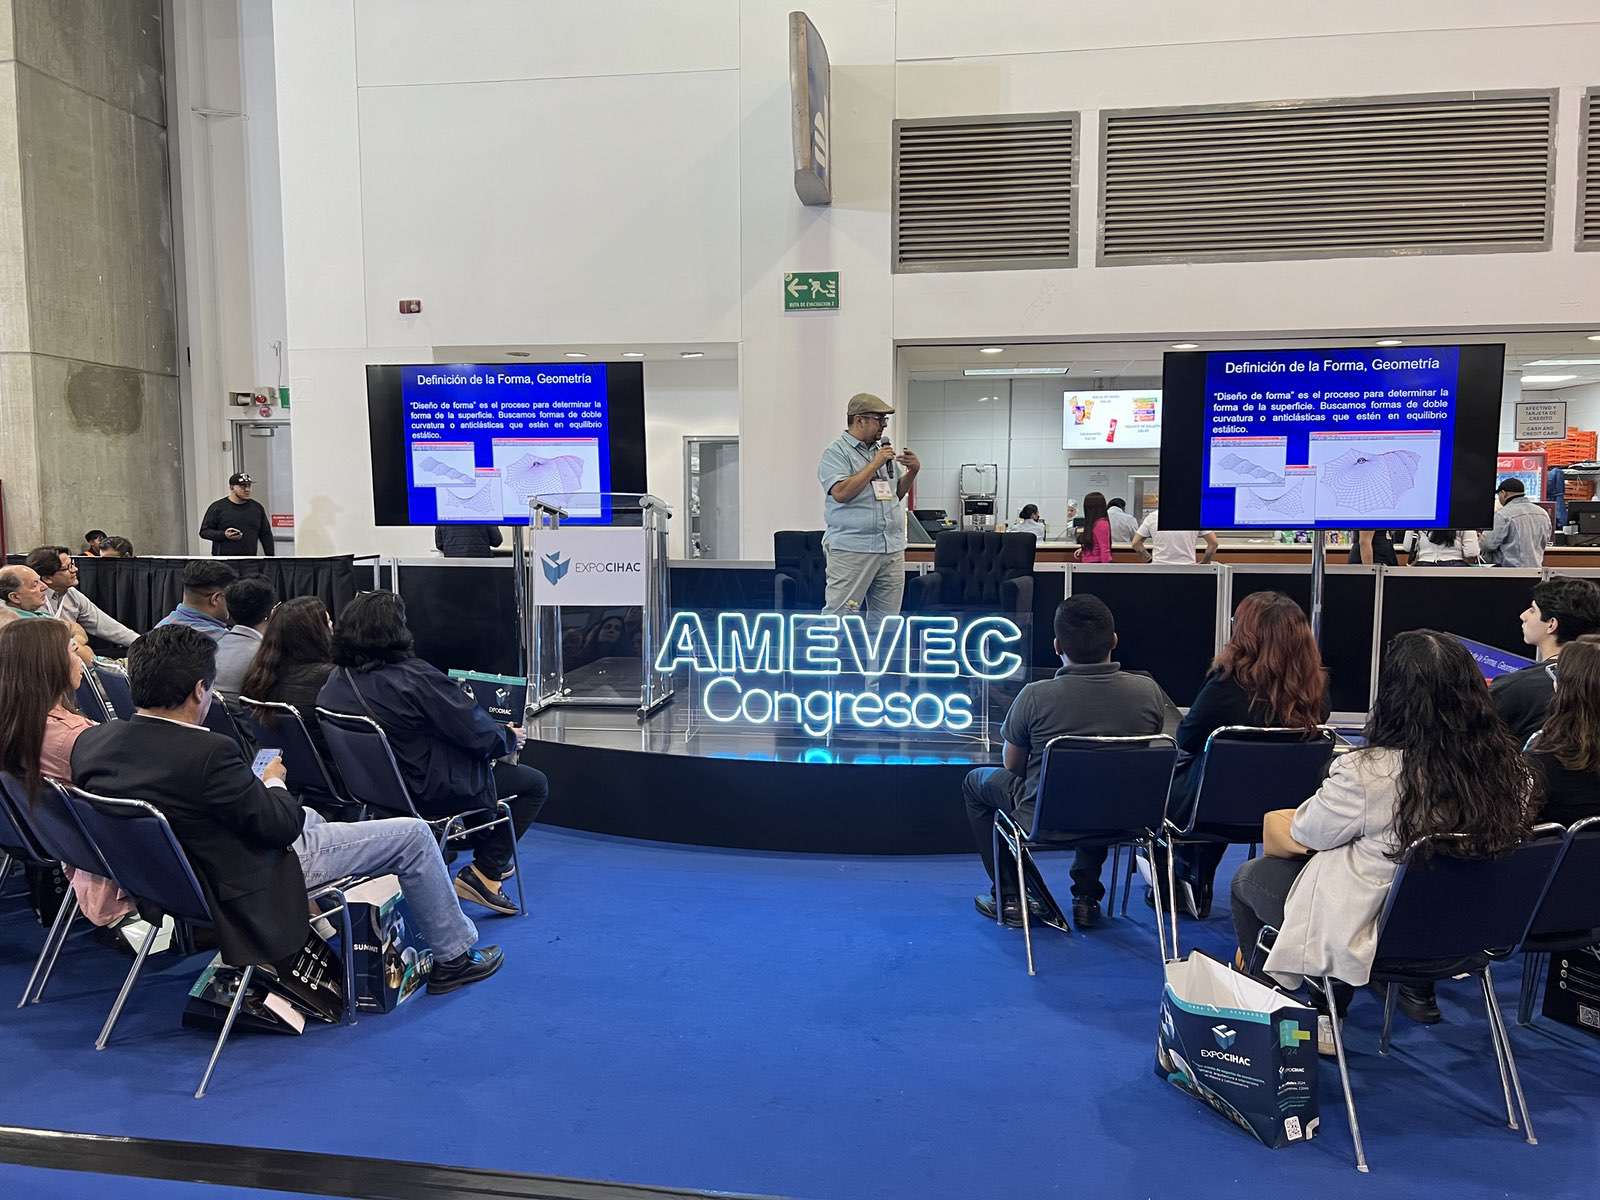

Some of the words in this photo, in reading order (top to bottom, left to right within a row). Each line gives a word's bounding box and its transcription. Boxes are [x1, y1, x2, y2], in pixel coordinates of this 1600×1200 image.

[1225, 361, 1286, 374] Definición
[1288, 360, 1306, 373] de
[1308, 360, 1320, 372] la
[1323, 359, 1368, 373] Forma,
[1371, 357, 1440, 371] Geometría
[416, 372, 468, 386] Definición
[469, 373, 483, 385] de
[485, 373, 496, 385] la
[497, 373, 534, 386] Forma,
[536, 372, 592, 385] Geometría
[1250, 391, 1263, 400] de
[1297, 392, 1310, 400] es
[1312, 390, 1321, 399] el
[1323, 391, 1361, 401] proceso
[1363, 390, 1385, 400] para
[1387, 388, 1437, 398] determinar
[1440, 388, 1449, 397] la
[440, 401, 451, 410] de
[490, 401, 499, 409] el
[500, 402, 531, 411] proceso
[532, 402, 550, 410] para
[551, 400, 592, 409] determinar
[594, 400, 602, 409] la
[1212, 403, 1239, 412] forma
[1242, 402, 1255, 412] de
[1258, 402, 1267, 411] la
[1319, 401, 1367, 410] Buscamos
[1370, 400, 1402, 410] formas
[1406, 399, 1419, 409] de
[1422, 399, 1449, 409] doble
[410, 411, 432, 420] forma
[434, 411, 445, 420] de
[447, 411, 455, 419] la
[497, 410, 537, 419] Buscamos
[539, 410, 565, 419] formas
[567, 410, 579, 419] de
[580, 410, 602, 419] doble
[1212, 414, 1254, 423] curvatura
[1259, 415, 1267, 423] o
[1271, 412, 1327, 422] anticlásticas
[1332, 413, 1350, 423] que
[1355, 411, 1381, 421] estén
[1387, 413, 1400, 421] en
[1406, 410, 1448, 421] equilibrio
[410, 421, 445, 430] curvatura
[449, 422, 456, 430] o
[508, 422, 524, 431] que
[528, 420, 550, 429] estén
[568, 420, 603, 430] equilibrio
[575, 562, 641, 573] EXPOCIHAC
[655, 611, 1022, 680] AMEVEC
[703, 676, 972, 736] Congresos
[1200, 1049, 1251, 1067] EXPOCIHAC
